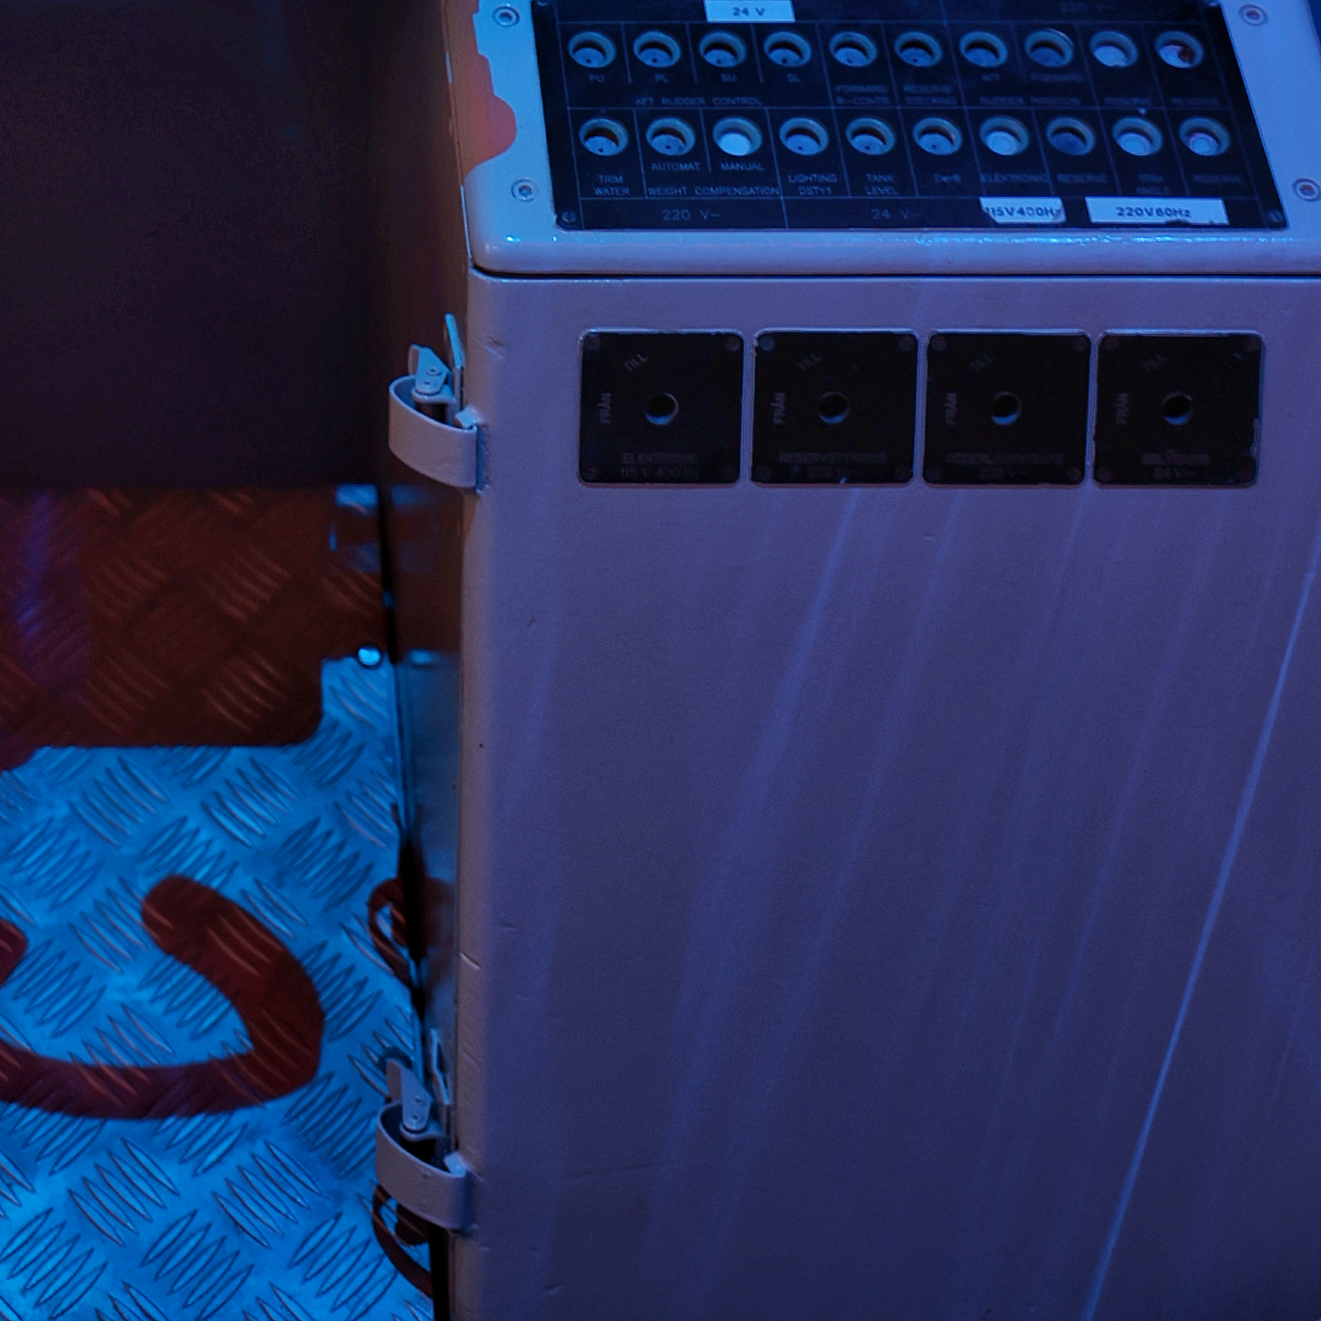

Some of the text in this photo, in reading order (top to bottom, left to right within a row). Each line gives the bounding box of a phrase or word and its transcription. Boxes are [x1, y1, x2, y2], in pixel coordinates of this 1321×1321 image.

[732, 7, 750, 17] 24
[635, 97, 762, 106] AFT RUDDER CONTROL
[651, 162, 700, 171] AUTOMAT
[721, 162, 764, 171] MANUAL
[598, 175, 623, 184] TRIM
[788, 174, 837, 184] LIGHTING
[866, 174, 894, 183] TANK
[595, 187, 629, 196] WATER
[648, 187, 779, 196] WEIGHT COMPENSATION
[867, 187, 899, 196] LEVEL
[662, 209, 691, 221] 220
[871, 209, 891, 219] 24
